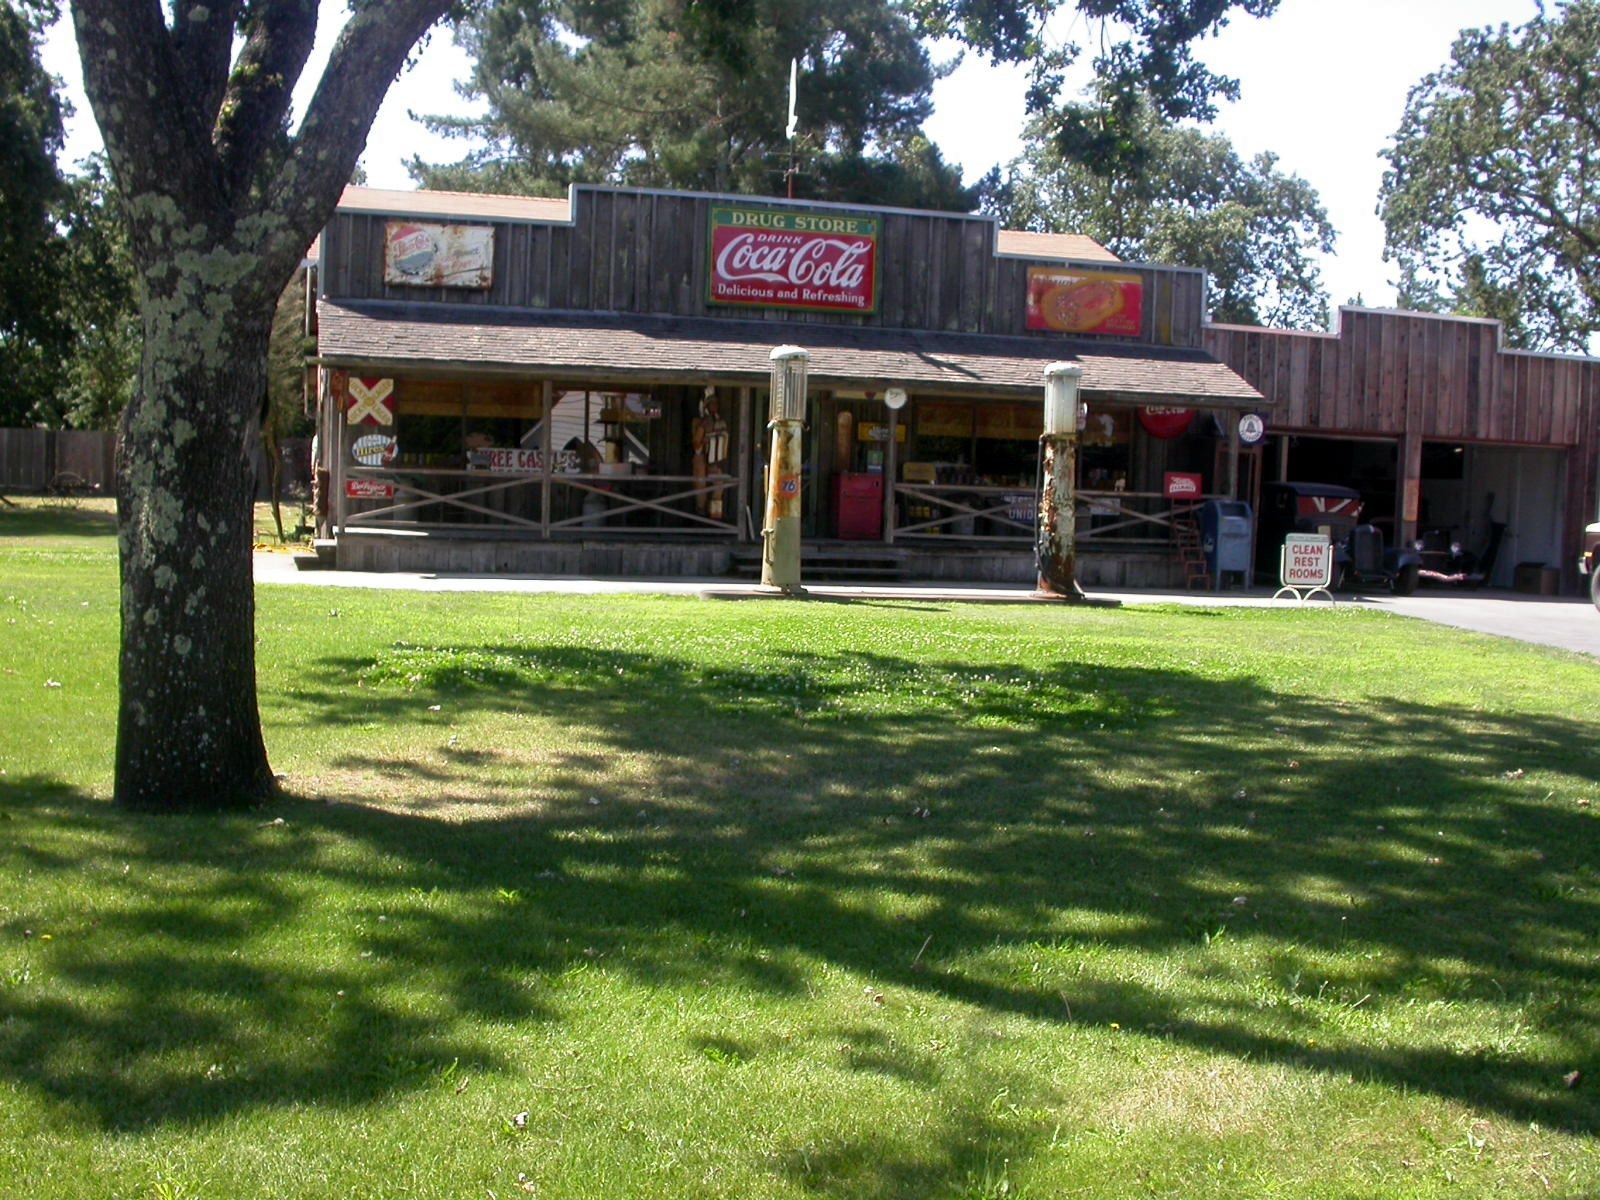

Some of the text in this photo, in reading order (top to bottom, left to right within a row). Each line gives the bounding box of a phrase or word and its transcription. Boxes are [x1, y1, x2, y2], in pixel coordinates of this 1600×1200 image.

[732, 212, 858, 233] DRUG STORE
[757, 234, 803, 244] DRINK
[716, 233, 872, 288] Coca-Cola
[718, 283, 865, 307] Delicious and Refreshing
[1292, 544, 1323, 555] CLEAN
[1294, 557, 1320, 567] REST
[1289, 568, 1324, 579] ROOMS
